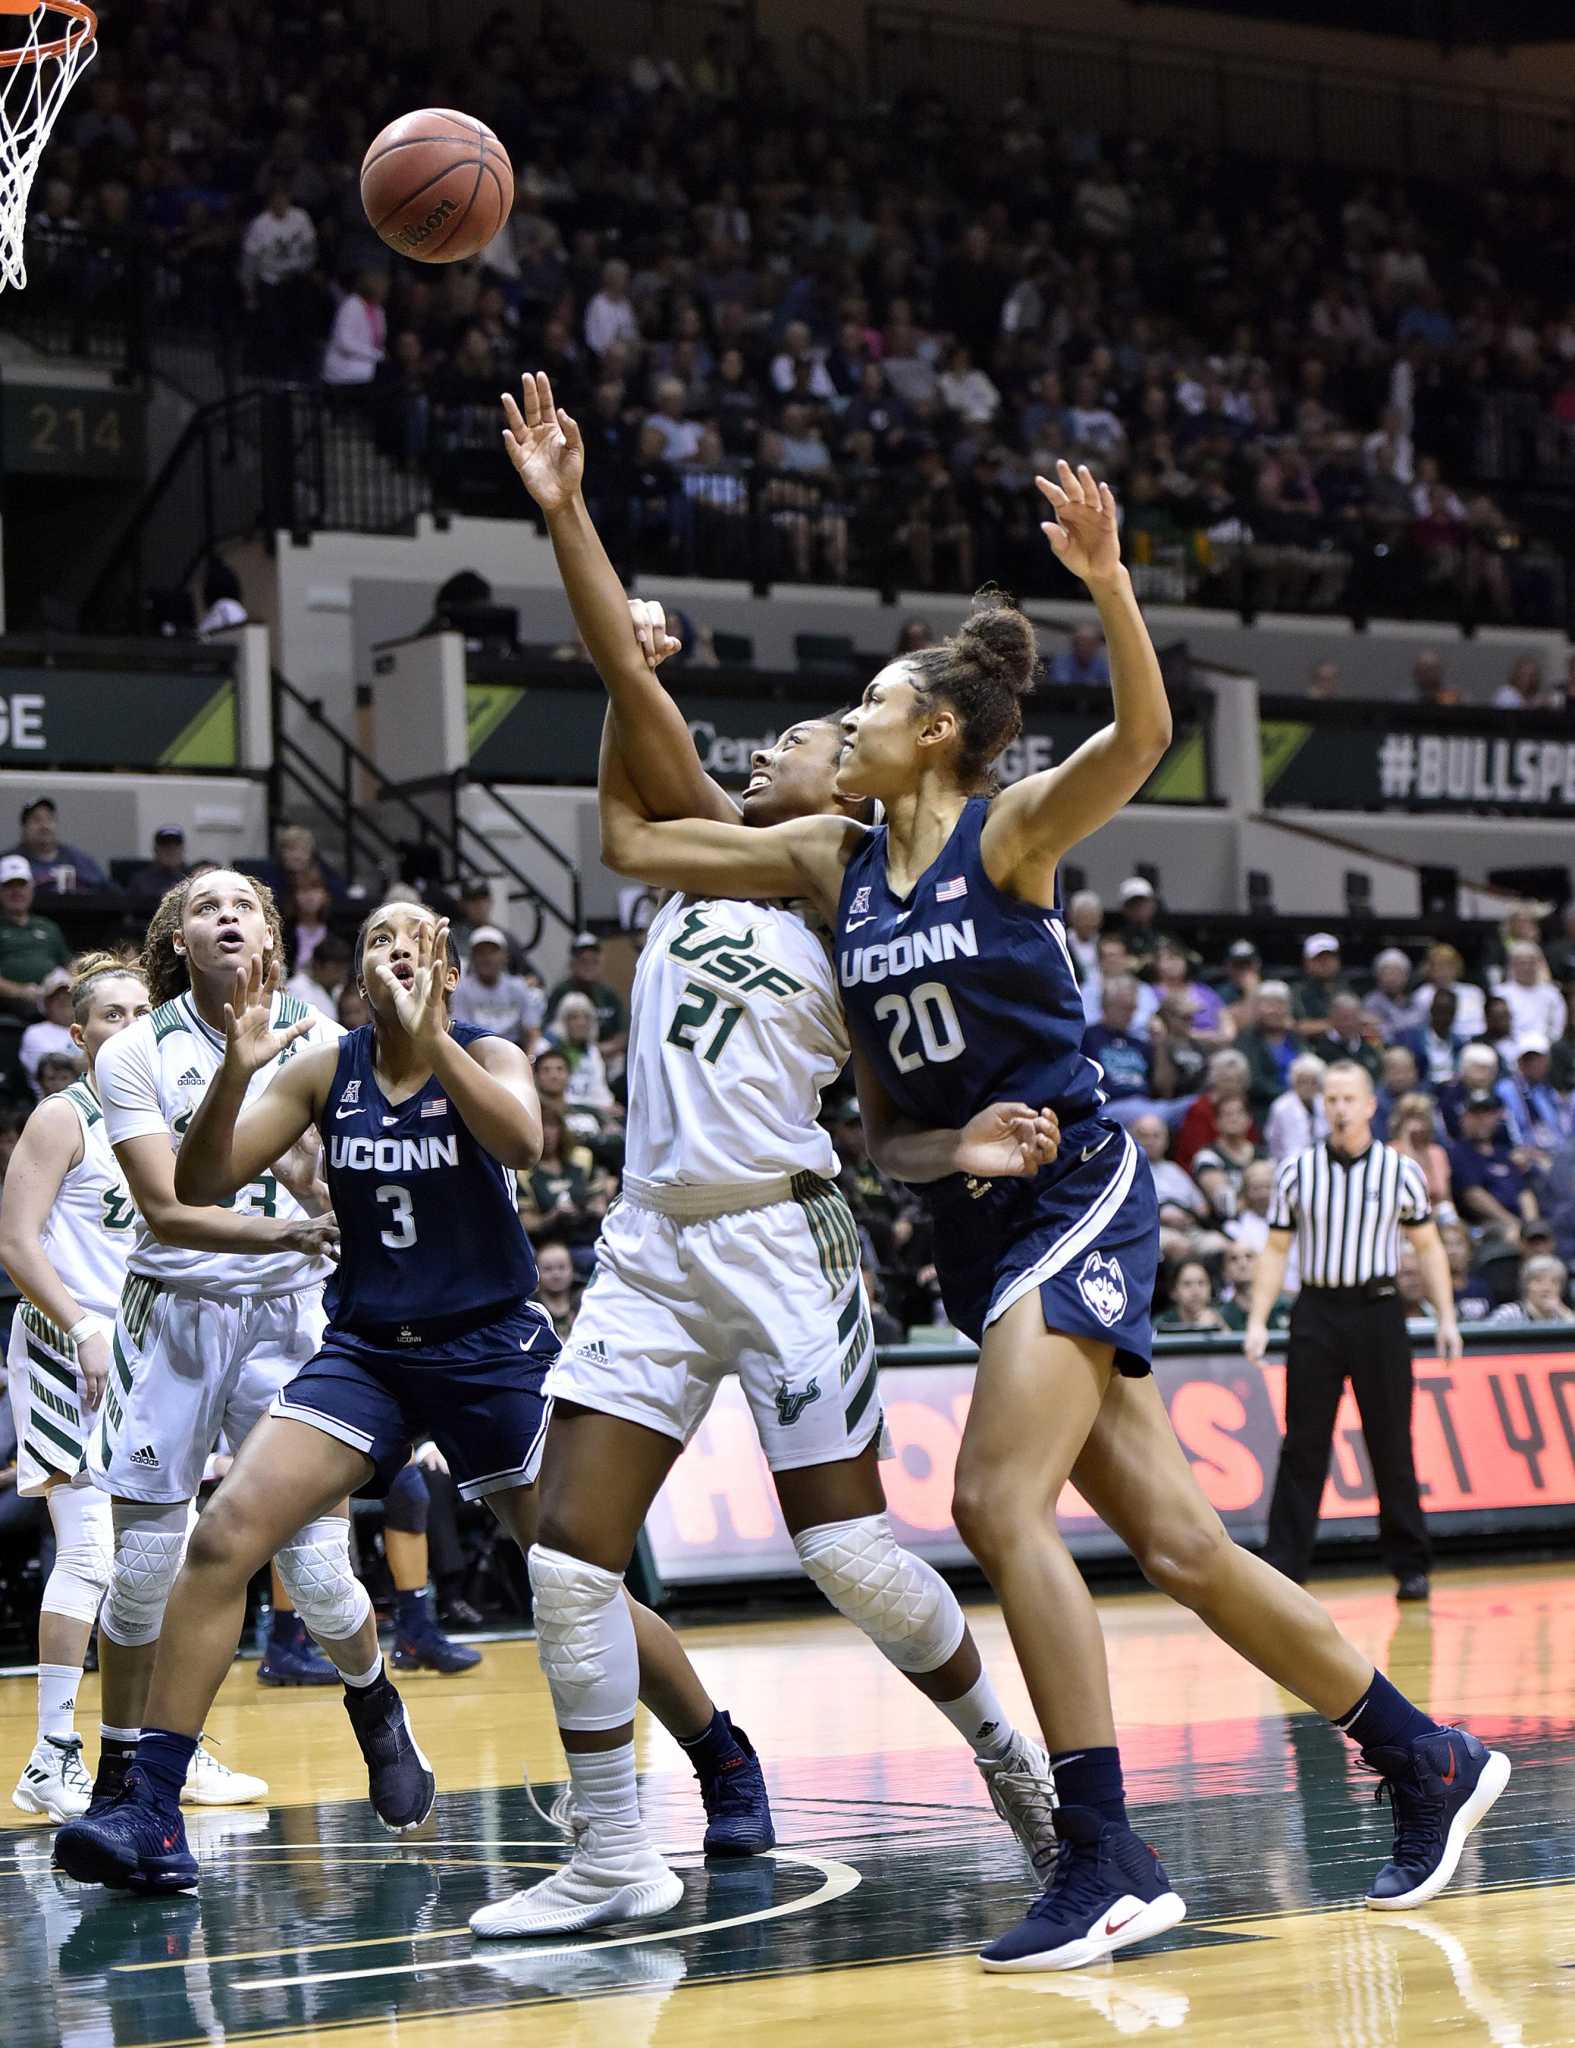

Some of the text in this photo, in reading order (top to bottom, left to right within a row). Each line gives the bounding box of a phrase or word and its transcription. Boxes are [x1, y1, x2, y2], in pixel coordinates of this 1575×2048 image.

[30, 404, 121, 454] 214
[0, 693, 47, 750] E
[669, 909, 806, 998] USF
[841, 919, 979, 988] UCONN
[666, 982, 744, 1065] 21
[874, 982, 967, 1074] 20
[330, 1134, 459, 1172] UCONN
[375, 1184, 418, 1249] 3
[576, 1350, 609, 1365] adidas
[129, 1455, 160, 1467] adidas
